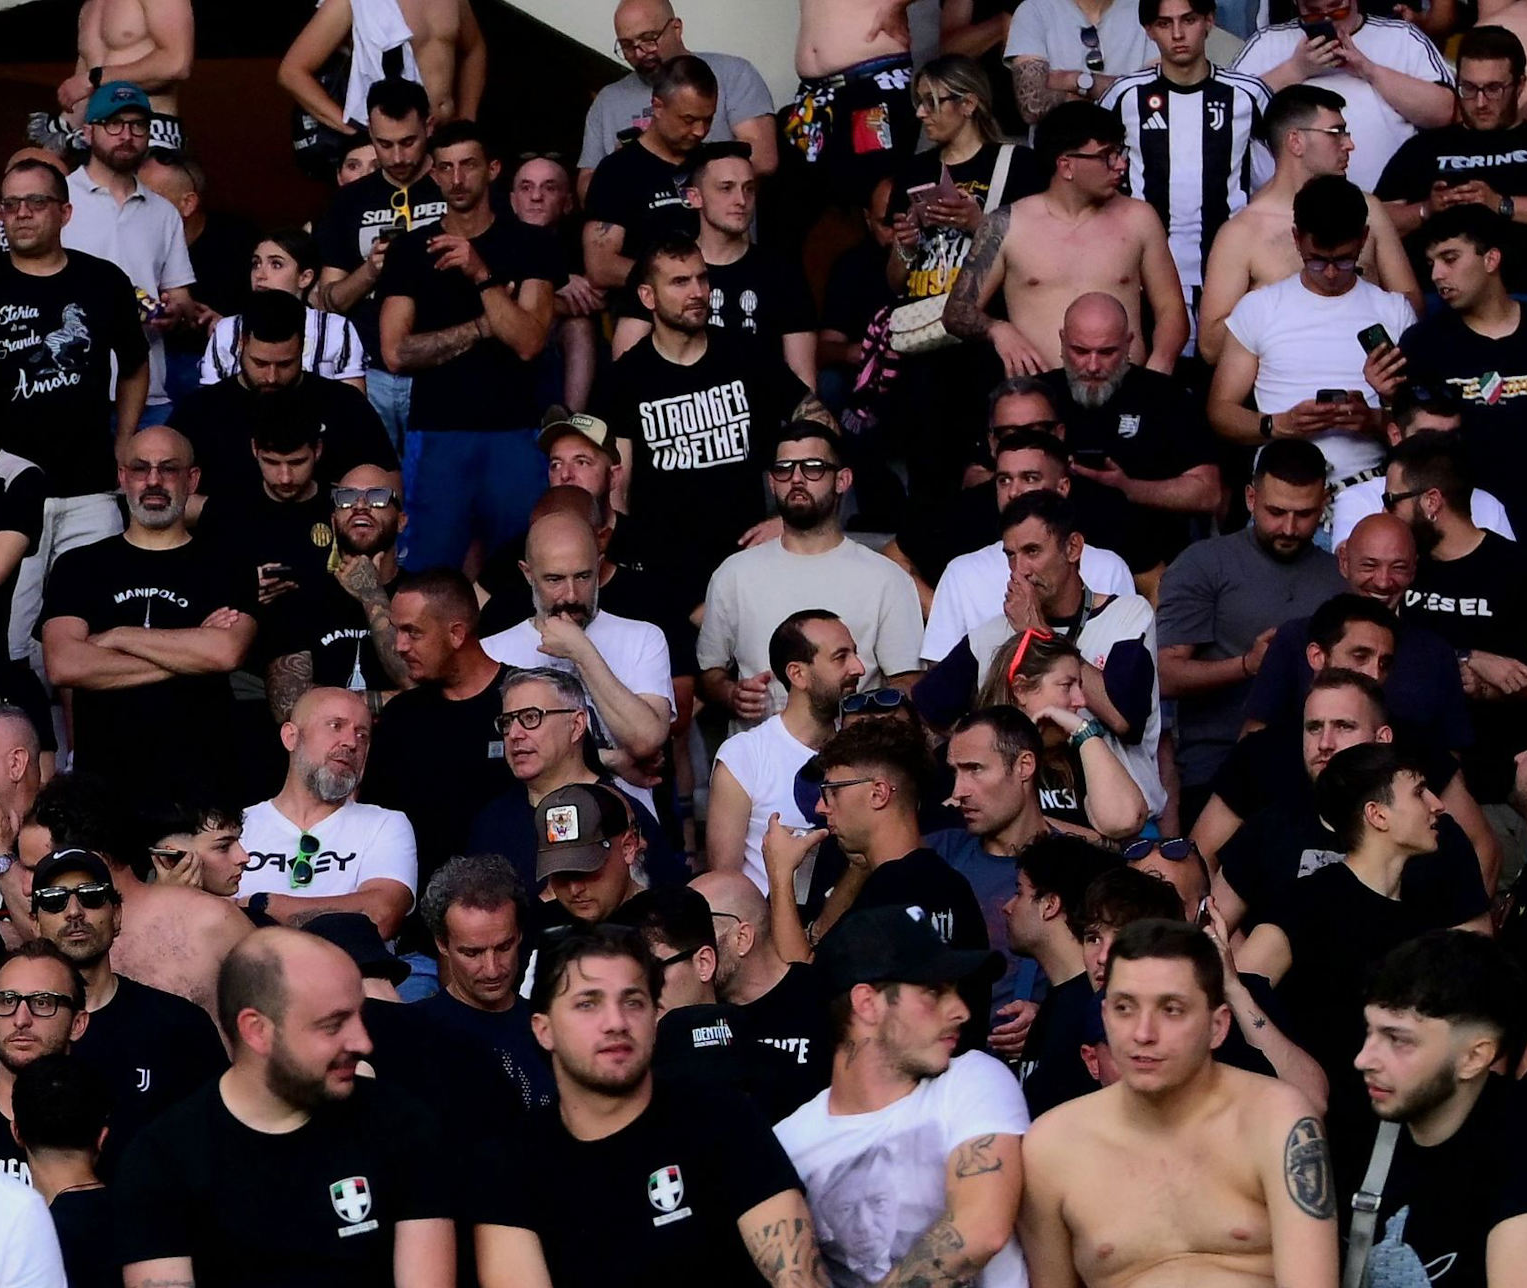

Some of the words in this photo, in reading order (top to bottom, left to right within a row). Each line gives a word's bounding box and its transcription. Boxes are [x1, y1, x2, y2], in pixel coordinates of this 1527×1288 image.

[414, 202, 448, 220] PER
[11, 368, 81, 402] Amore
[639, 380, 750, 442] STRONGER
[114, 587, 189, 609] MANIPOLO
[1405, 589, 1494, 617] DESEL
[320, 628, 371, 647] MANIP
